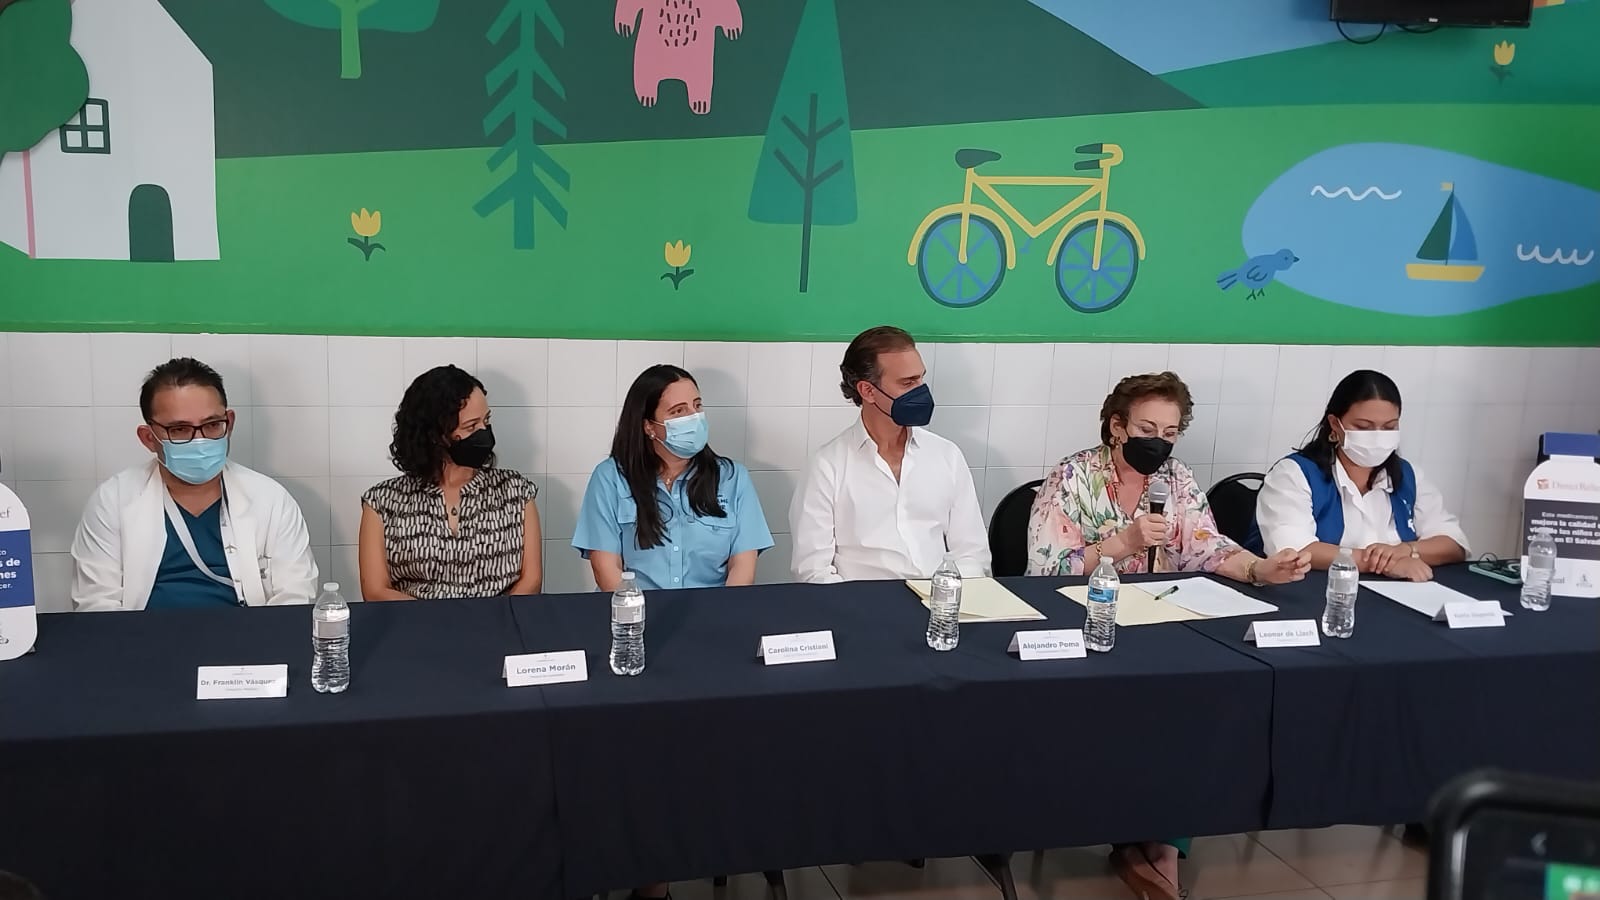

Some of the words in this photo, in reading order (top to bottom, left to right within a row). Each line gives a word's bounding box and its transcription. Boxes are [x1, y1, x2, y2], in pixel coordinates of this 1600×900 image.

[6, 557, 21, 567] de
[767, 645, 799, 654] Carolina
[799, 643, 829, 651] Cristiani
[1023, 642, 1058, 650] Alejandro
[1059, 641, 1080, 649] Poma
[516, 666, 547, 674] Lorena
[549, 663, 576, 671] Morán
